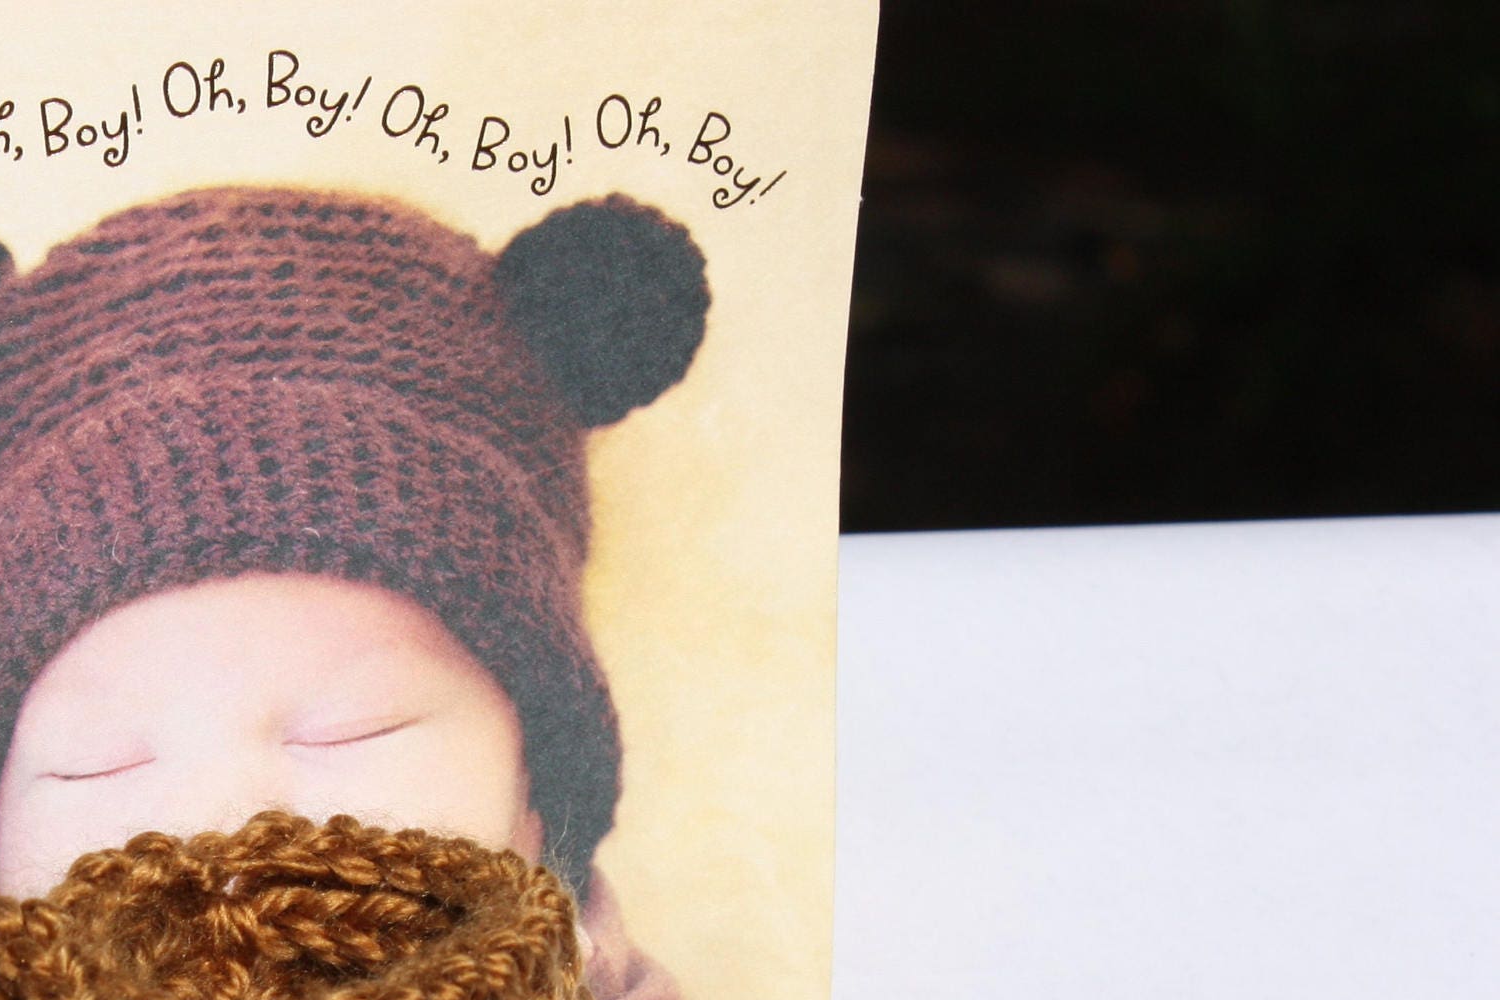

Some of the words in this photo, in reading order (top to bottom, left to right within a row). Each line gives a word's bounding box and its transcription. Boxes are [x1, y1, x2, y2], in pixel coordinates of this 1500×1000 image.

[40, 84, 143, 168] Boy!
[162, 58, 246, 118] Oh,
[266, 50, 372, 138] Boy!
[381, 85, 449, 164] Oh,
[471, 116, 574, 197] Boy!
[596, 95, 670, 156] Oh,
[687, 111, 787, 210] Boy!
